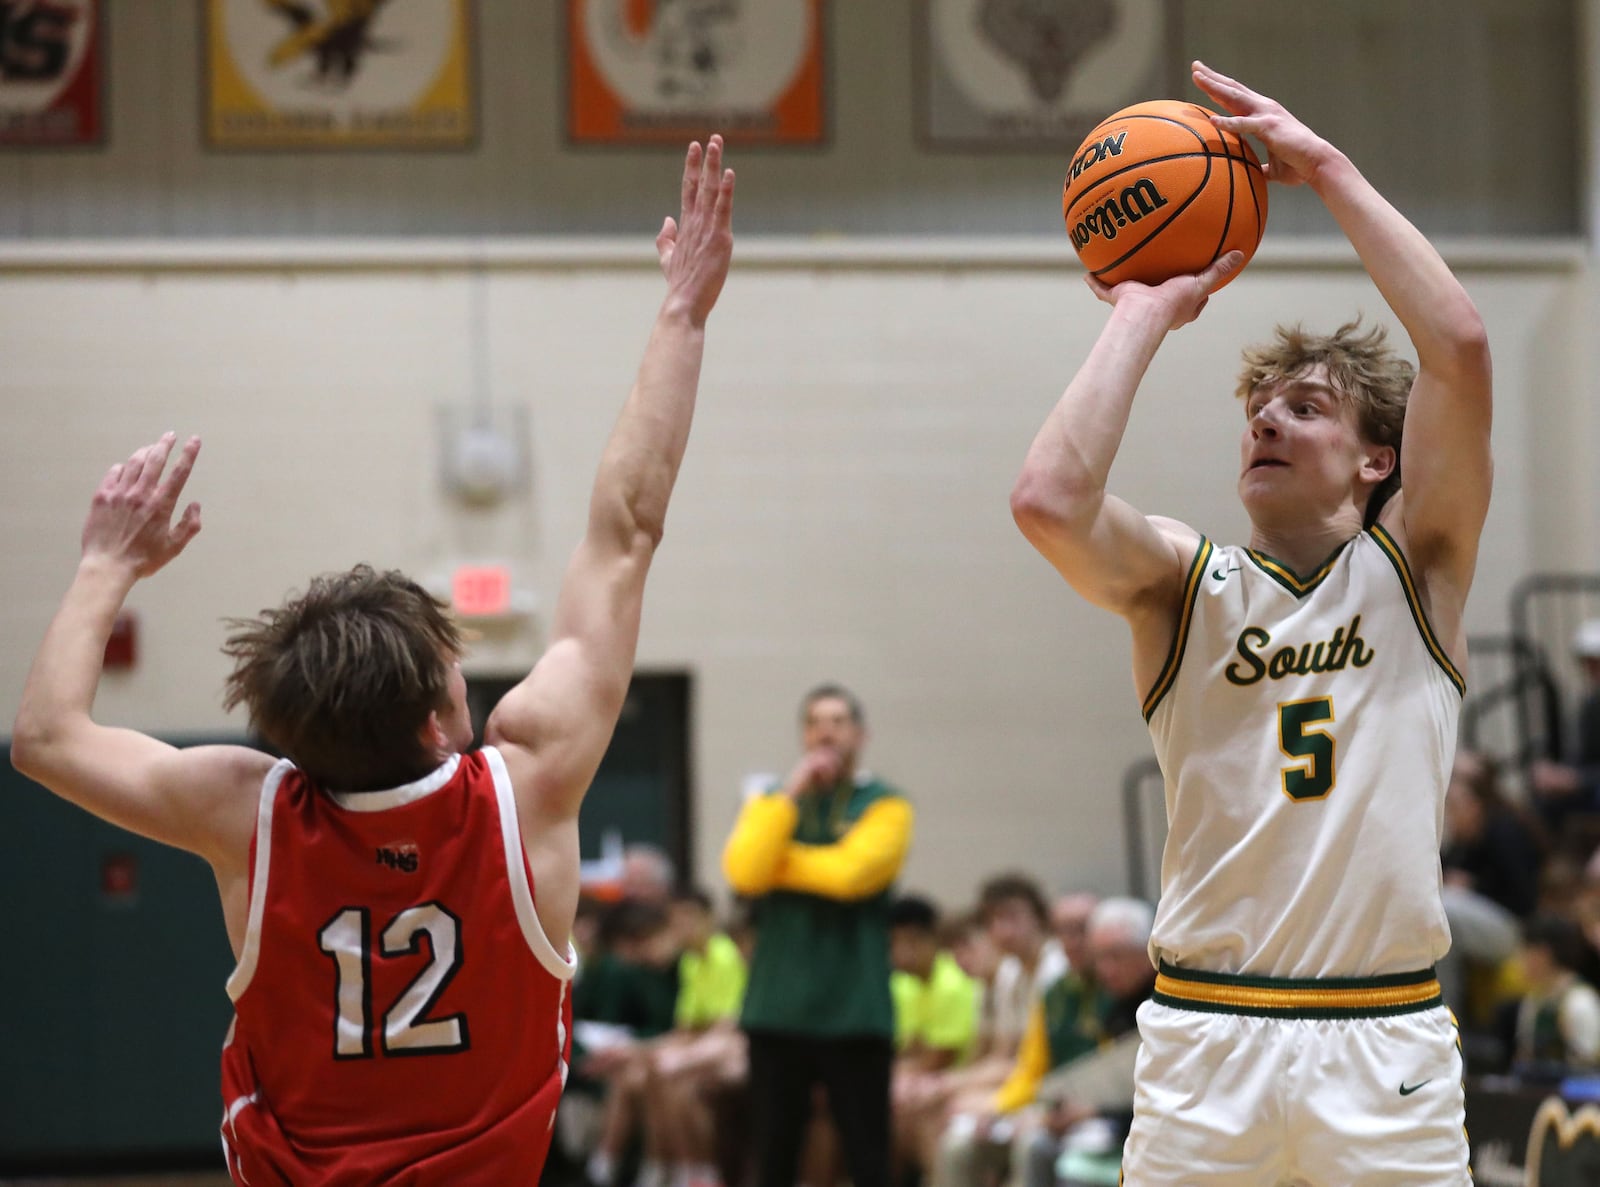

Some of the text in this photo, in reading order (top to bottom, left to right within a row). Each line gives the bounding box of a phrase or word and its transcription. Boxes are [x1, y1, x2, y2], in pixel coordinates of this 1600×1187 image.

[1069, 177, 1169, 252] Wilson
[1225, 614, 1375, 686] South
[1277, 695, 1336, 803] 5
[317, 900, 471, 1061] 12
